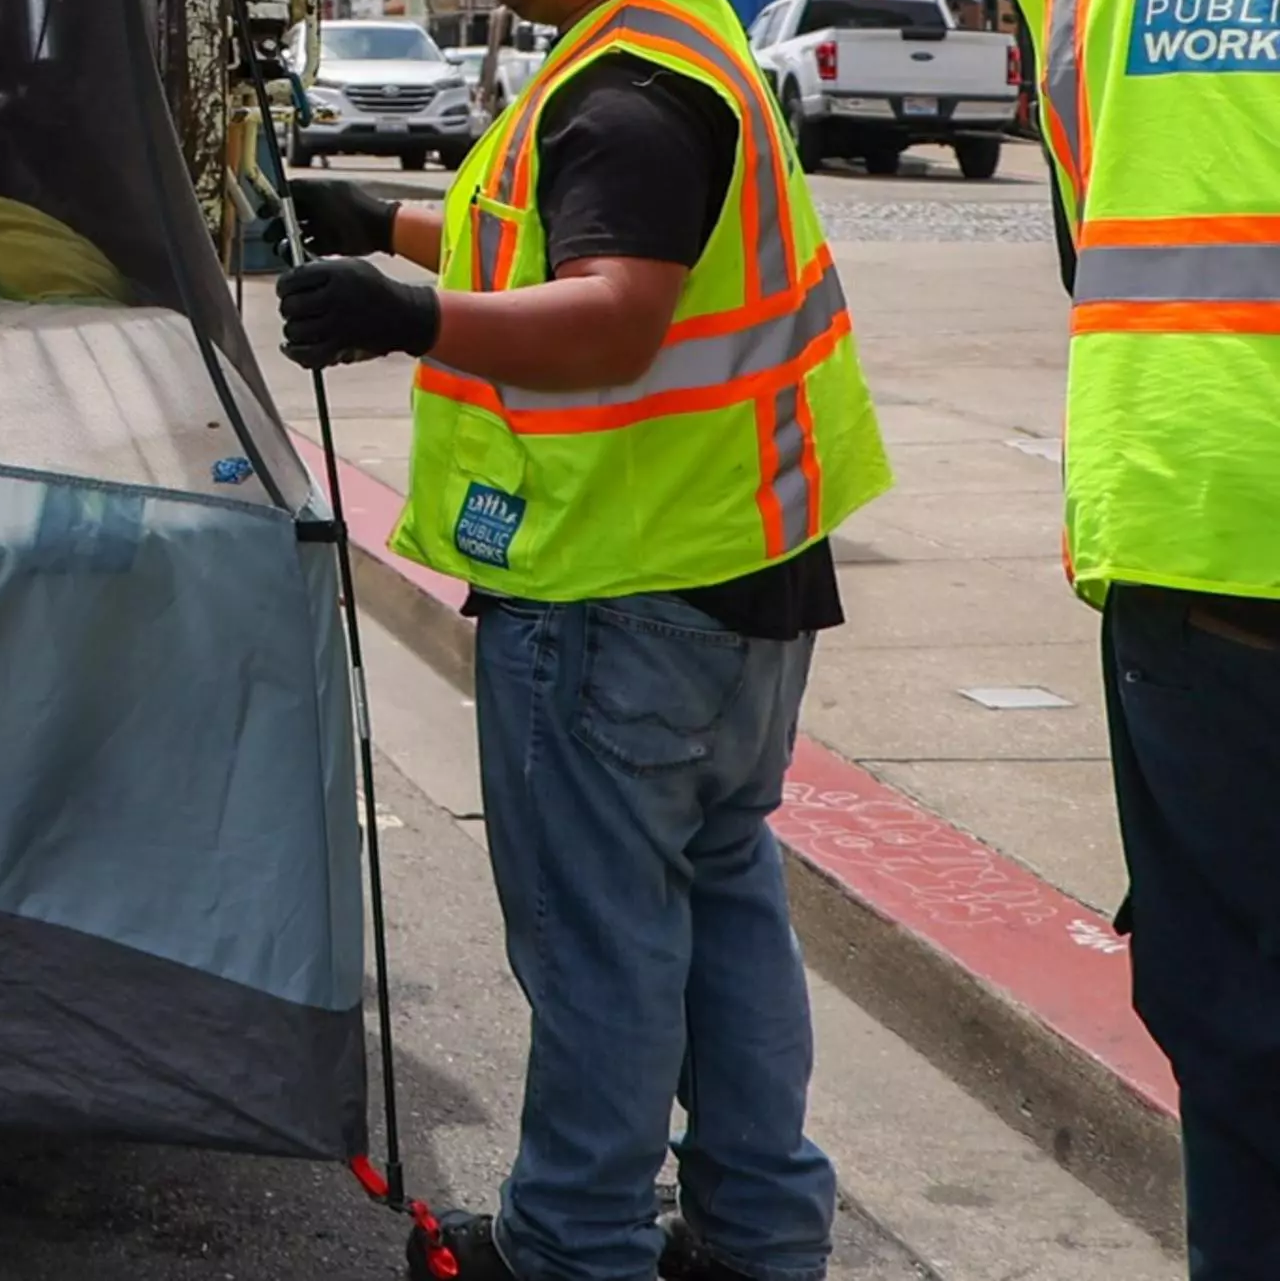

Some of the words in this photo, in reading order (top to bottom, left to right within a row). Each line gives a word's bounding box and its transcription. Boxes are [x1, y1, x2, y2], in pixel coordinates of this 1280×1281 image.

[1143, 29, 1280, 63] WORK
[458, 518, 509, 548] PUBLIC
[457, 535, 505, 563] WORKS
